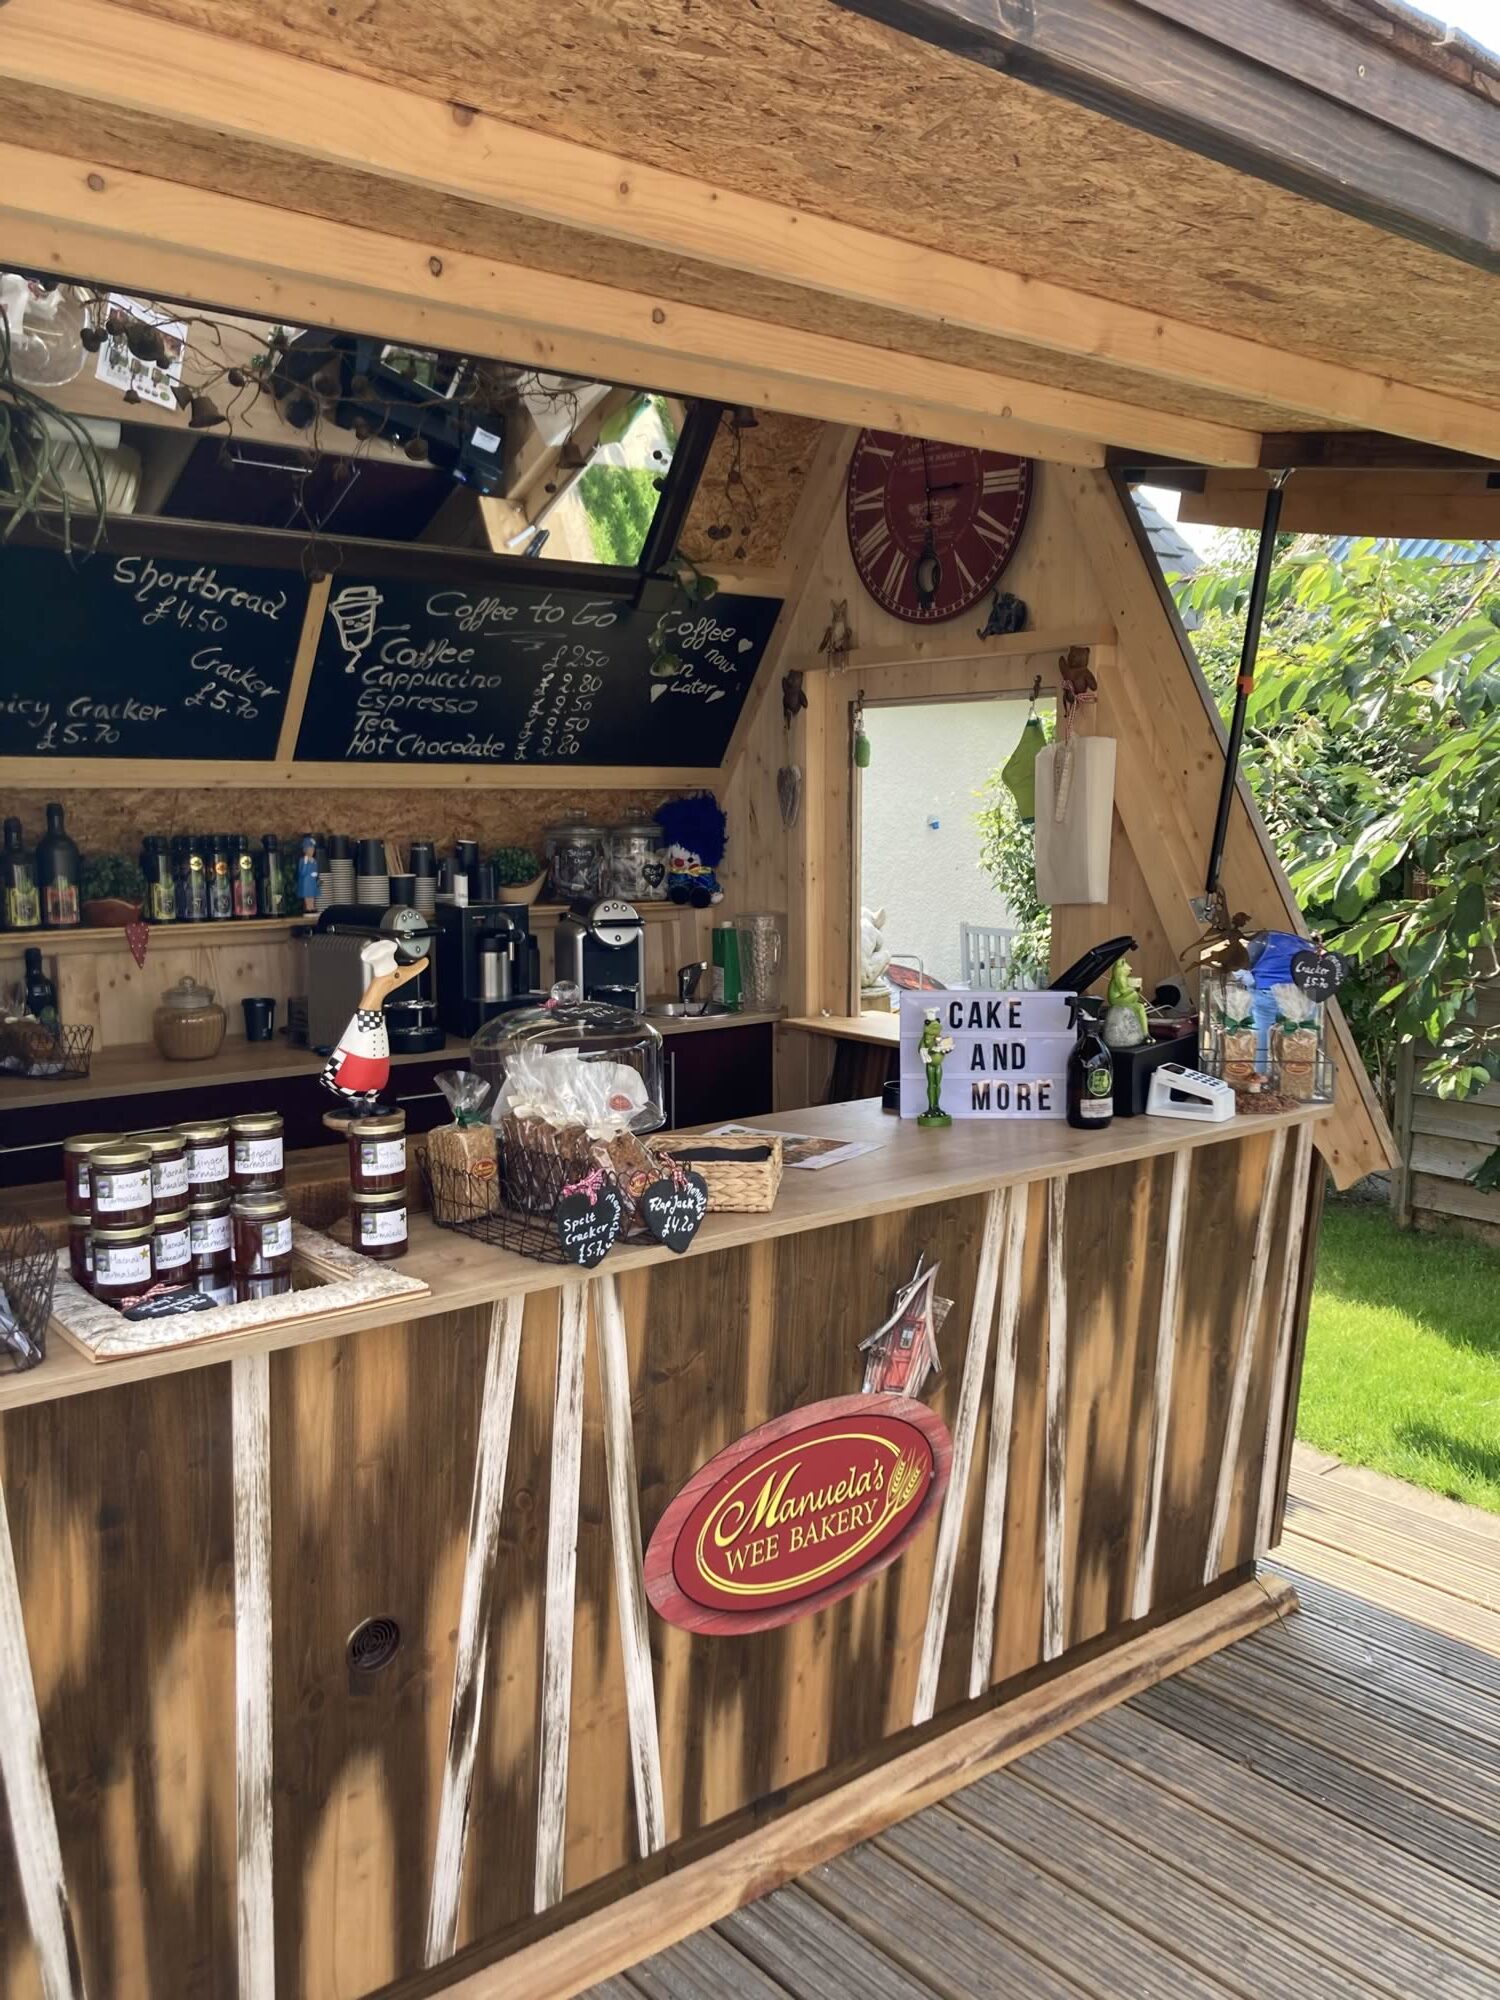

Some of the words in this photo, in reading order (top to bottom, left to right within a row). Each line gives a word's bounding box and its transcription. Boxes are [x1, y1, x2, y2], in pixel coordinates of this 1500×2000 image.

[113, 556, 287, 620] Shortbread
[142, 596, 228, 632] £4.50
[426, 591, 518, 631] Coffee
[529, 593, 565, 623] to
[572, 601, 618, 628] Go
[380, 637, 476, 669] Coffee
[190, 647, 281, 698] Cracker
[361, 665, 502, 692] Cappuccino
[0, 692, 50, 728] icy
[66, 697, 167, 721] Cracker
[356, 688, 479, 714] Espresso
[353, 710, 401, 732] Tea
[346, 733, 393, 757] Hot
[395, 733, 506, 758] Chocolate
[949, 1000, 1022, 1029] CAKE
[970, 1042, 1026, 1071] AND
[971, 1082, 1051, 1111] MORE
[563, 1212, 597, 1232] Spelt
[565, 1223, 609, 1245] Cracker
[714, 1458, 886, 1548] Manuela's
[725, 1534, 780, 1576] WEE
[789, 1498, 879, 1553] BAKERY
